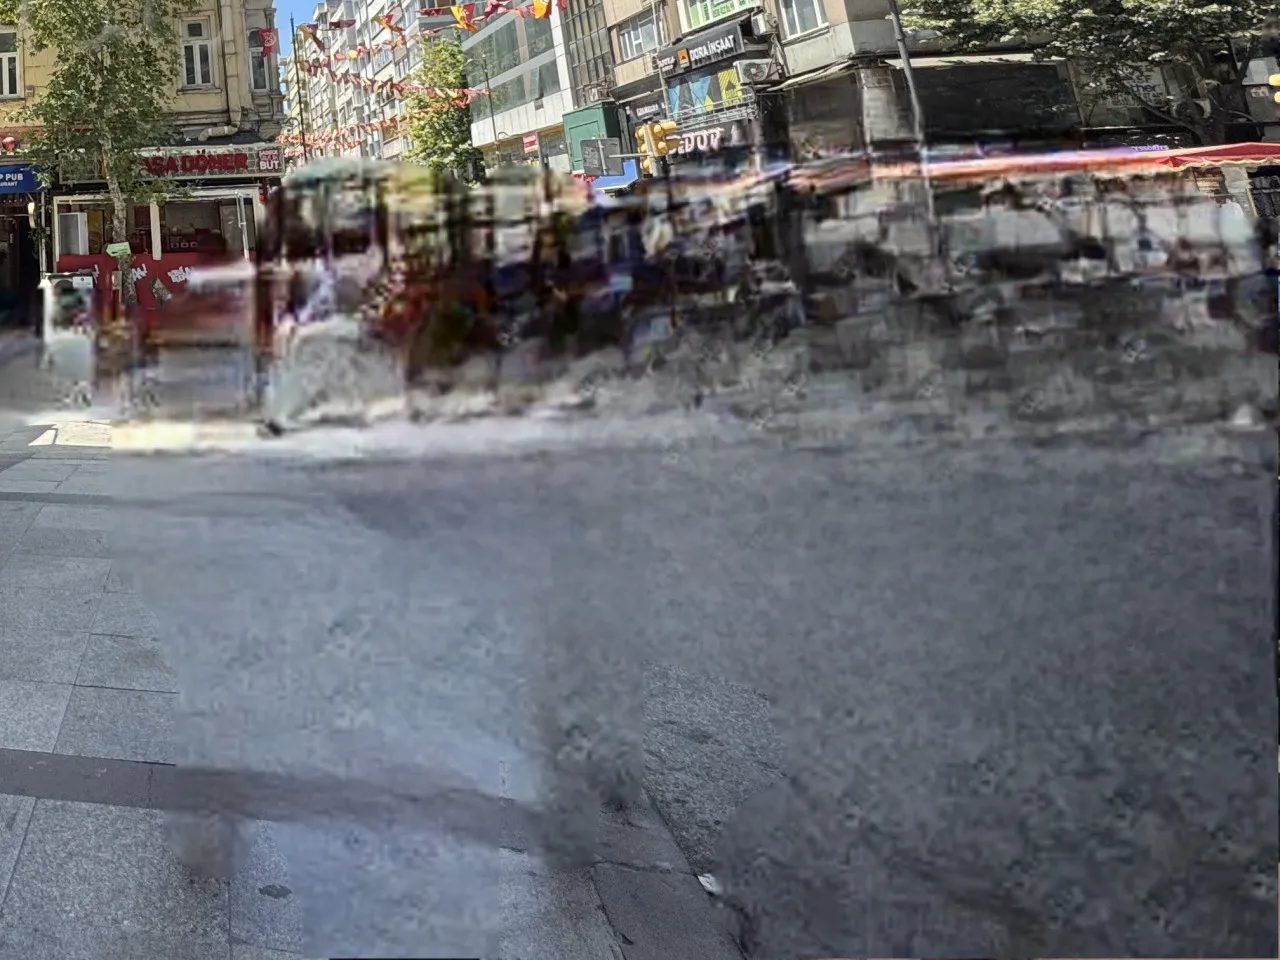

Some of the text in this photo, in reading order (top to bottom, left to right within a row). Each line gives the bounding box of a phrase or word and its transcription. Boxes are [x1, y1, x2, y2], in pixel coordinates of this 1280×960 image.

[181, 148, 249, 173] DÖNER
[260, 160, 279, 170] BUT
[6, 173, 23, 181] PUB
